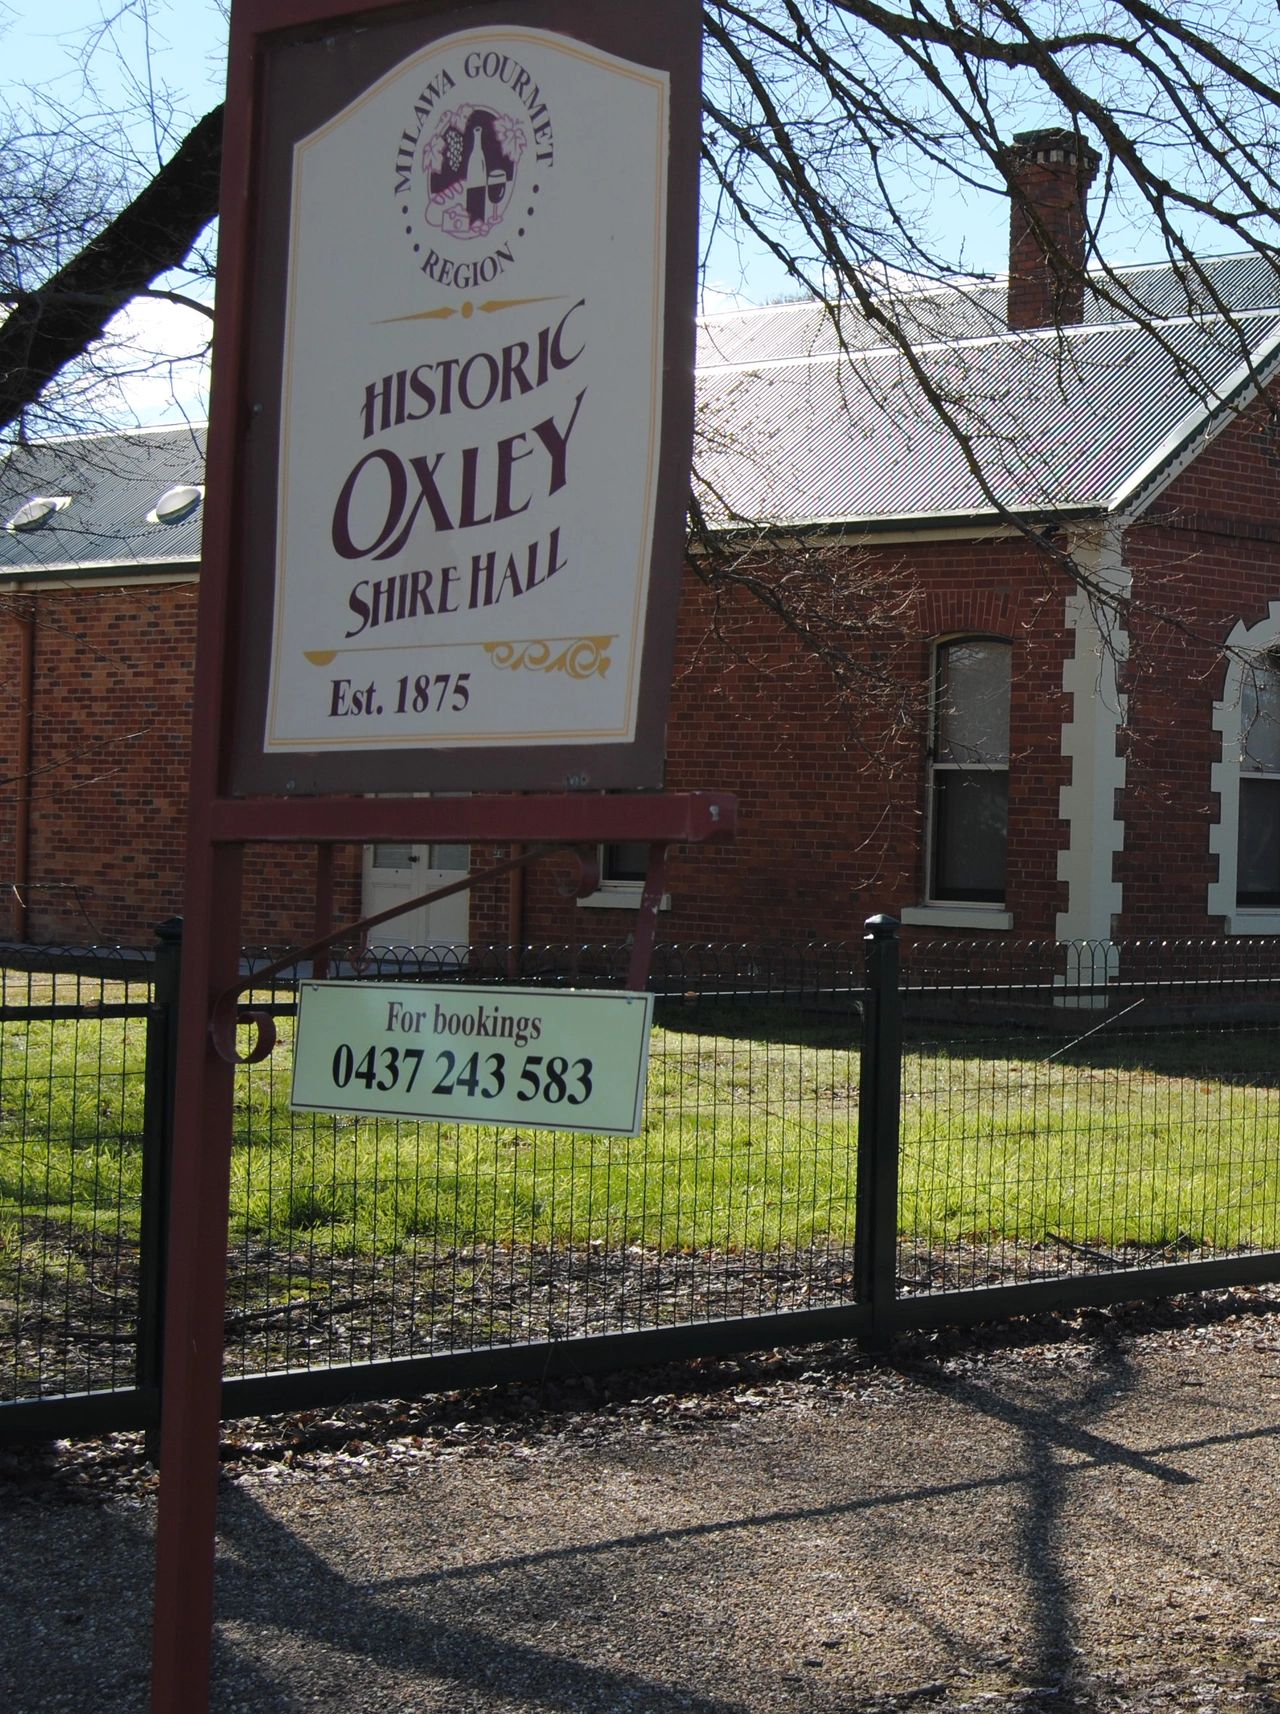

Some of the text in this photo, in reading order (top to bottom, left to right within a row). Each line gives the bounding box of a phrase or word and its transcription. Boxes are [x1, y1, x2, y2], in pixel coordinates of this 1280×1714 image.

[394, 51, 554, 197] MILAWA GOURMET
[420, 240, 515, 289] REGION
[359, 298, 586, 440] HISTORIC
[331, 385, 588, 561] OXLEY
[344, 526, 568, 639] SHIRE HALL
[328, 673, 471, 717] Est. 1875
[385, 1001, 542, 1048] For bookings
[332, 1043, 593, 1105] 0437 243 583
